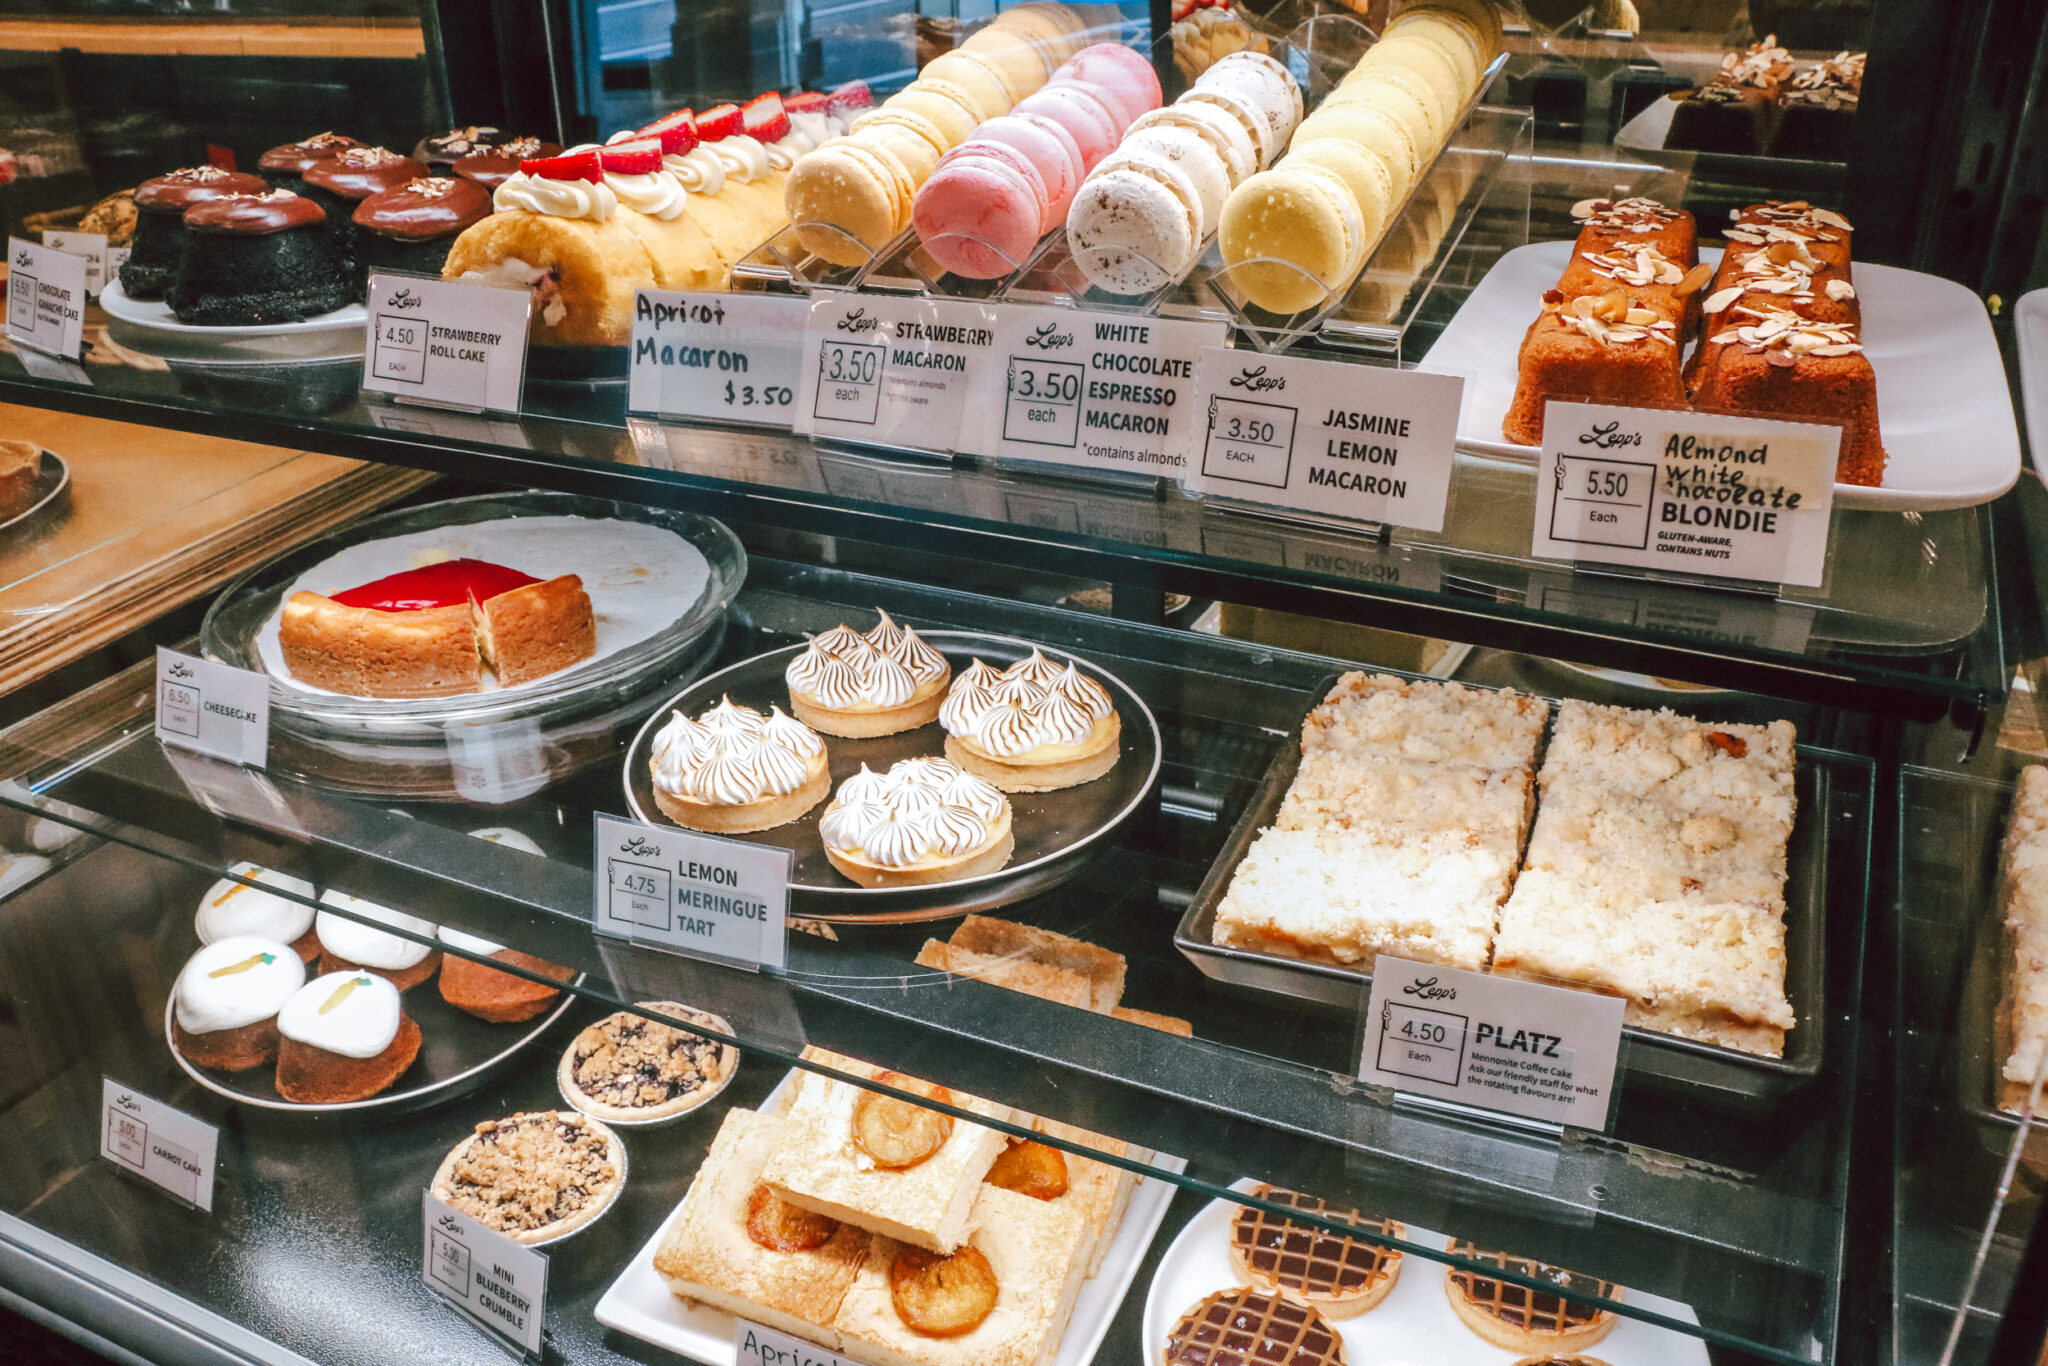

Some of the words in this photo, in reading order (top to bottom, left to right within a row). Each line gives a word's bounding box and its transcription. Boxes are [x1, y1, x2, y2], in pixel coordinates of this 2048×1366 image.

[38, 282, 71, 301] CHOCOLATE
[388, 289, 422, 309] Lepp's
[38, 299, 63, 316] GANACHE
[64, 307, 79, 321] CAKE
[637, 293, 725, 330] Apricot
[837, 307, 879, 333] Lepp's
[386, 327, 414, 345] 4.50
[432, 326, 502, 346] STRAWBERRY
[896, 322, 994, 346] STRAWBERRY
[1026, 322, 1074, 350] Lepp's
[1095, 322, 1149, 344] WHITE
[430, 345, 455, 359] ROLL
[459, 349, 485, 363] CAKE
[636, 336, 748, 373] Macaron
[829, 348, 876, 383] 3.50
[892, 349, 966, 372] MACARON
[1092, 352, 1192, 379] CHOCOLATE
[388, 362, 406, 372] EACH
[1230, 366, 1287, 391] Lepp's
[835, 387, 860, 401] each
[918, 380, 946, 390] almonds
[1018, 369, 1078, 401] 3.50
[1088, 381, 1177, 406] ESPRESSO
[1028, 408, 1056, 423] each
[1085, 410, 1169, 435] MACARON
[1322, 409, 1411, 437] JASMINE
[1227, 418, 1274, 442] 3.50
[1579, 421, 1642, 448] Lepp's
[1137, 449, 1188, 468] almonds
[1226, 450, 1255, 463] EACH
[1327, 439, 1398, 466] LEMON
[1665, 433, 1768, 465] Almond
[1308, 467, 1407, 498] MACARON
[1587, 470, 1628, 498] 5.50
[1589, 511, 1618, 524] Each
[1661, 502, 1777, 534] BLONDIE
[1656, 544, 1703, 557] CONTAINS
[1705, 549, 1730, 559] NUTS
[168, 688, 190, 705] 6.50
[621, 836, 661, 857] Lepp's
[624, 874, 655, 894] 4.75
[679, 860, 738, 887] LEMON
[631, 900, 649, 911] Each
[678, 888, 768, 921] MERINGUE
[677, 915, 715, 937] TART
[1403, 977, 1457, 1000] Lepp's
[1401, 1020, 1445, 1043] 4.50
[1476, 1022, 1562, 1058] PLATZ
[1408, 1050, 1432, 1063] Each
[1471, 1052, 1519, 1069] Mennonite
[1520, 1061, 1549, 1074] Coffee
[1550, 1067, 1572, 1079] Cake
[1467, 1075, 1482, 1085] the
[1484, 1078, 1519, 1094] rotating
[1520, 1085, 1556, 1100] flavours
[1558, 1094, 1576, 1104] are!
[1469, 1064, 1485, 1074] Ask
[1486, 1068, 1502, 1077] our
[1504, 1069, 1538, 1086] friendly
[1540, 1077, 1560, 1088] staff
[1561, 1081, 1574, 1091] for
[1575, 1085, 1598, 1096] what
[153, 1145, 182, 1166] CARROT
[183, 1161, 202, 1177] CAKE
[493, 1263, 515, 1286] MINI
[476, 1272, 530, 1314] BLUEBERRY
[479, 1294, 524, 1330] CRUMBLE
